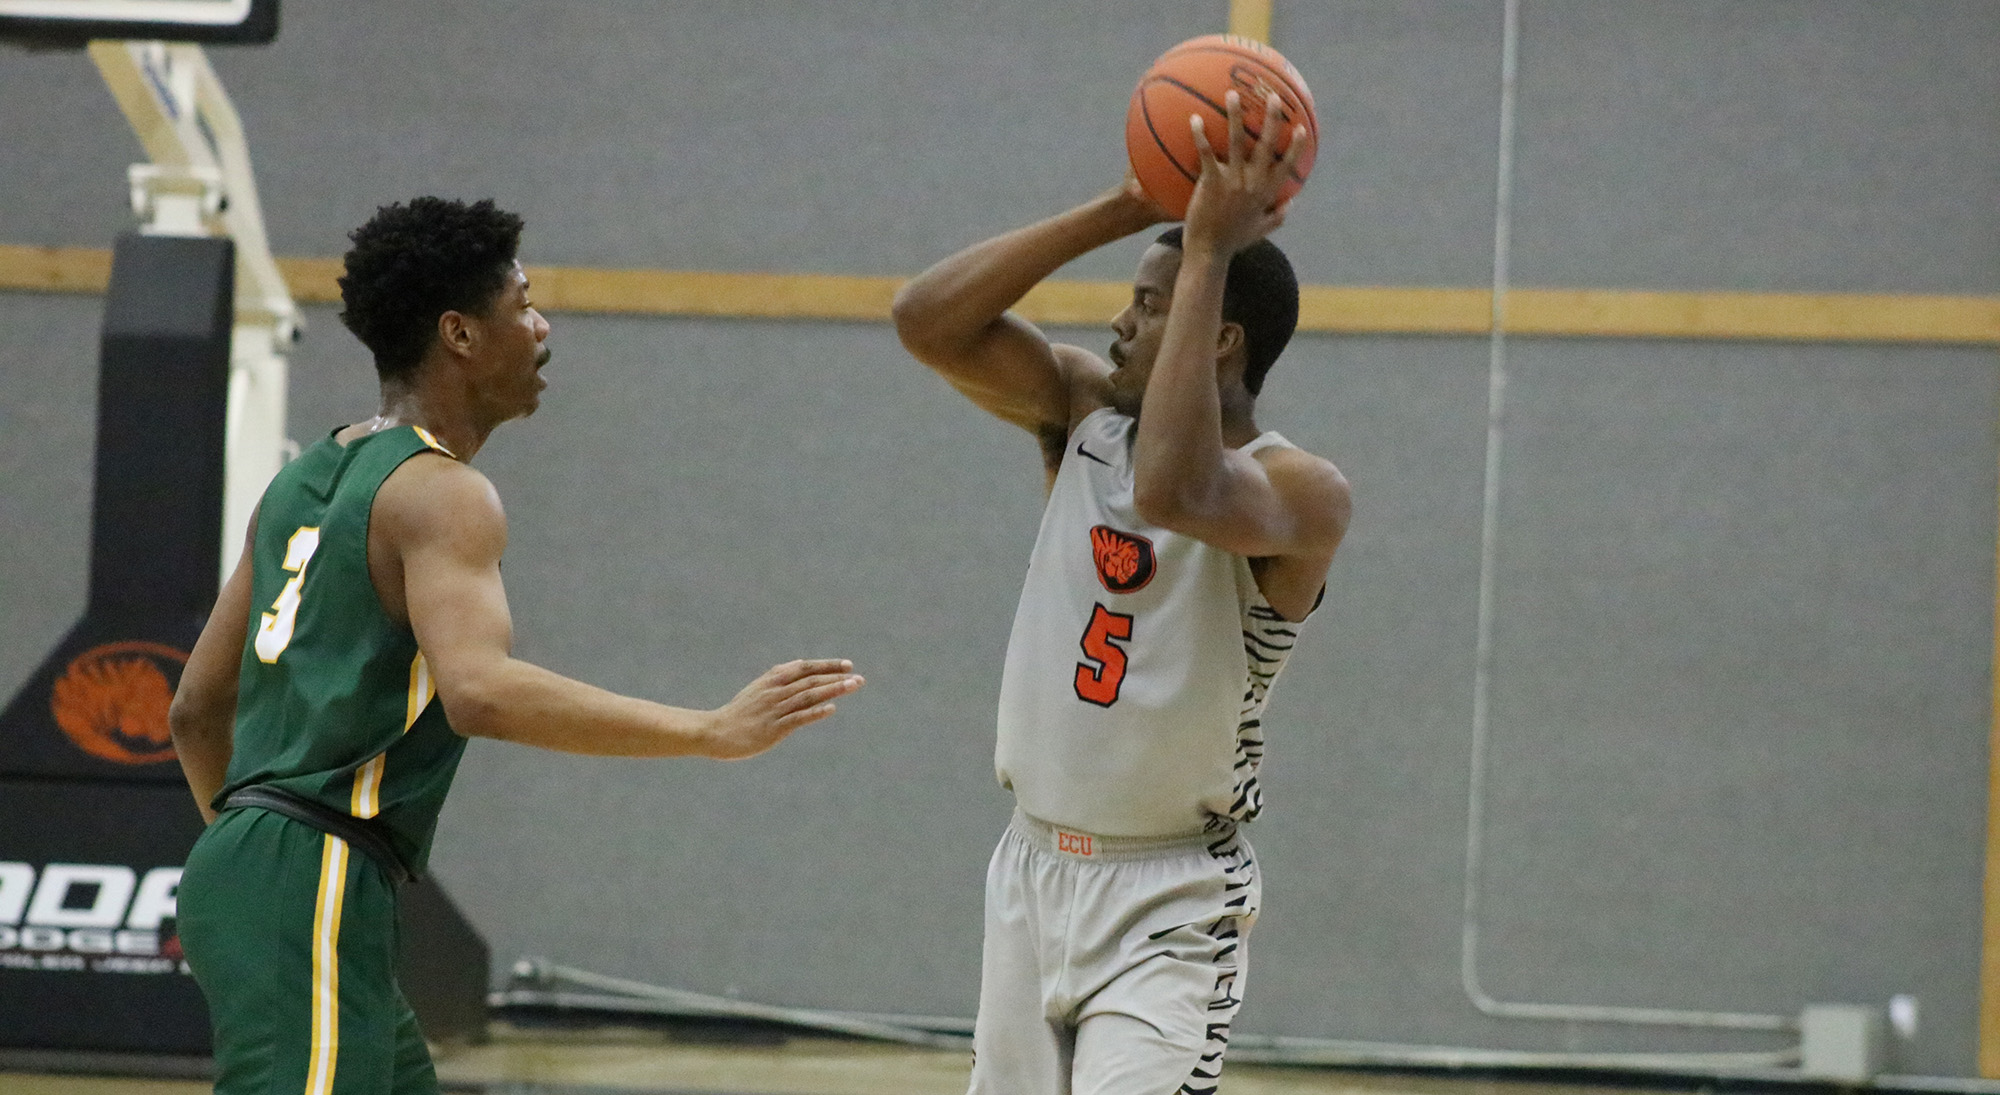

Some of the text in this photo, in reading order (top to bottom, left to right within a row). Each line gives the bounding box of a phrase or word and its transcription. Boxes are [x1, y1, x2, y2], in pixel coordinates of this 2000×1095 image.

[255, 526, 320, 664] 3
[1074, 602, 1134, 708] 5
[1058, 831, 1092, 856] ECU
